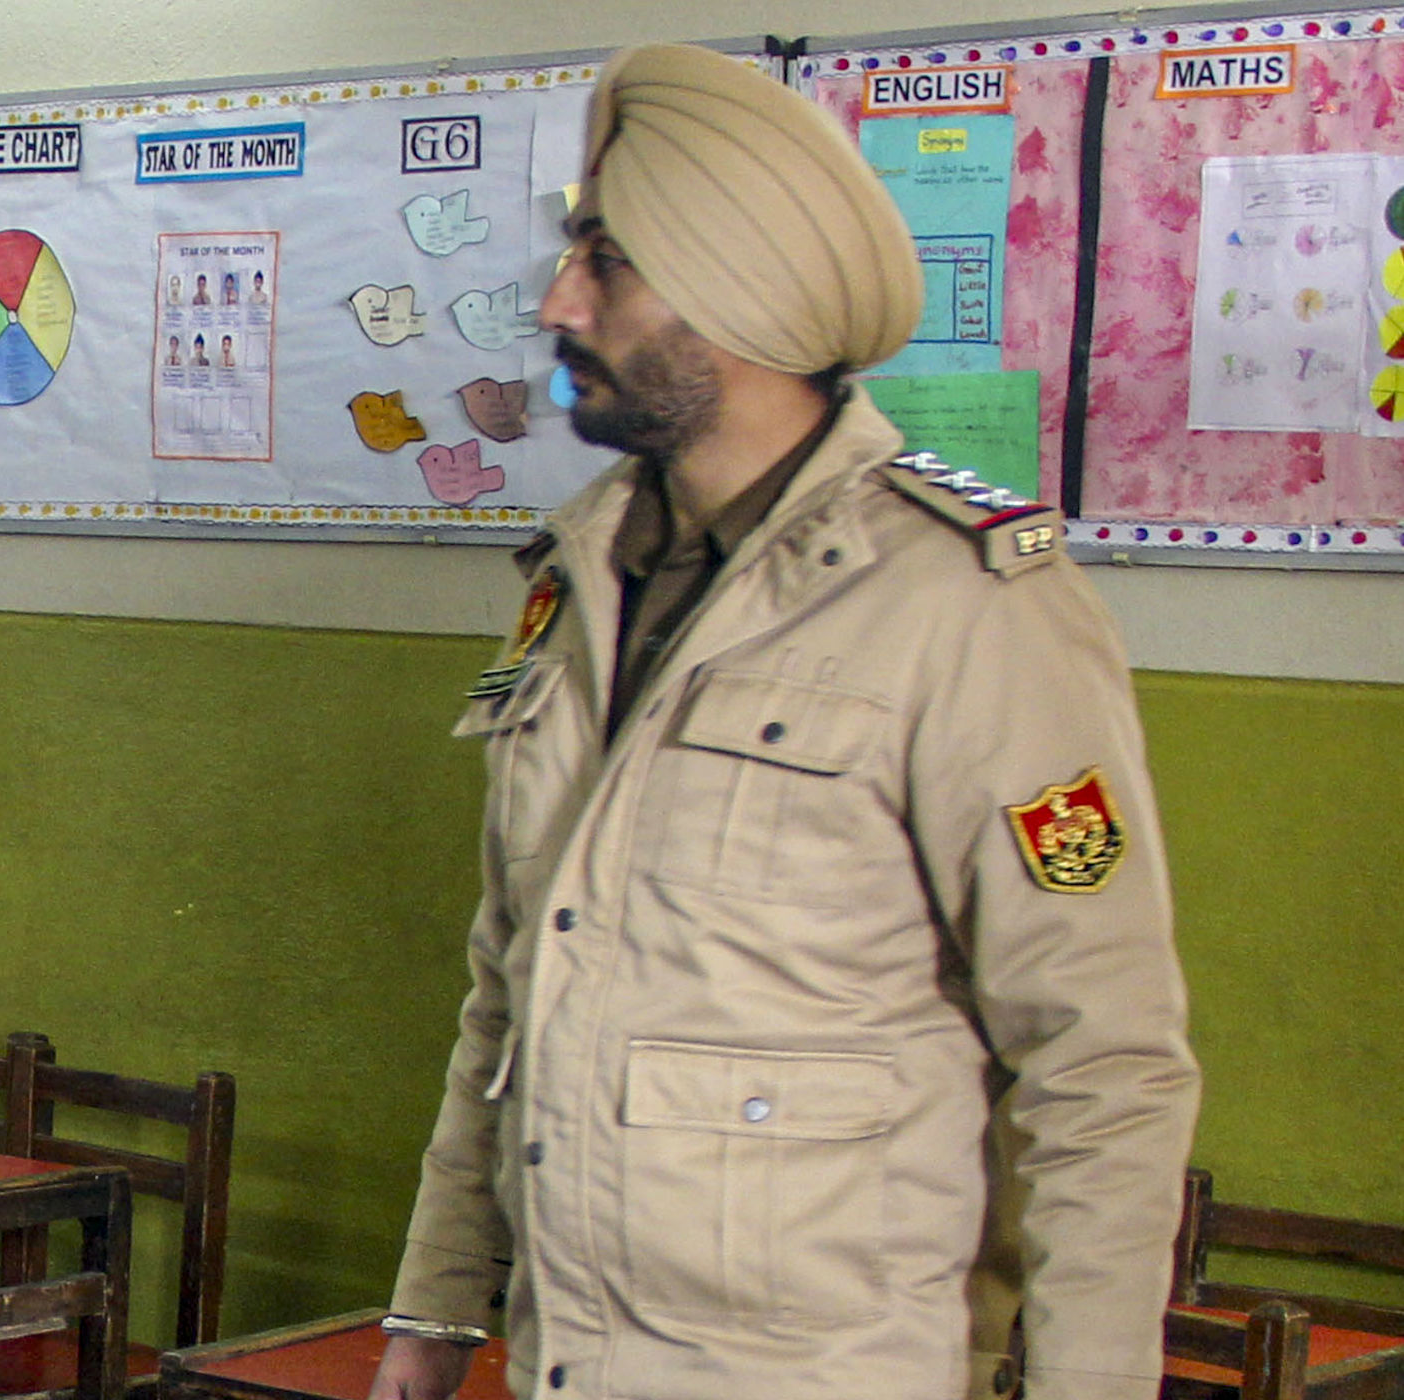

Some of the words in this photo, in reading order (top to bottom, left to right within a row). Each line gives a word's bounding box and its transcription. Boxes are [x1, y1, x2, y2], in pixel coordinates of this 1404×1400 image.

[874, 72, 1002, 103] ENGLISH
[1171, 56, 1284, 88] MATHS
[12, 131, 76, 163] CHART
[145, 145, 176, 172] STAR
[183, 143, 201, 170] OF
[208, 141, 233, 168] THE
[241, 138, 296, 167] MONTH
[410, 122, 469, 162] G6
[180, 248, 199, 257] STAR
[201, 247, 212, 256] OF
[214, 246, 229, 255] THE
[233, 246, 264, 255] MONTH
[918, 246, 983, 259] ynonyms
